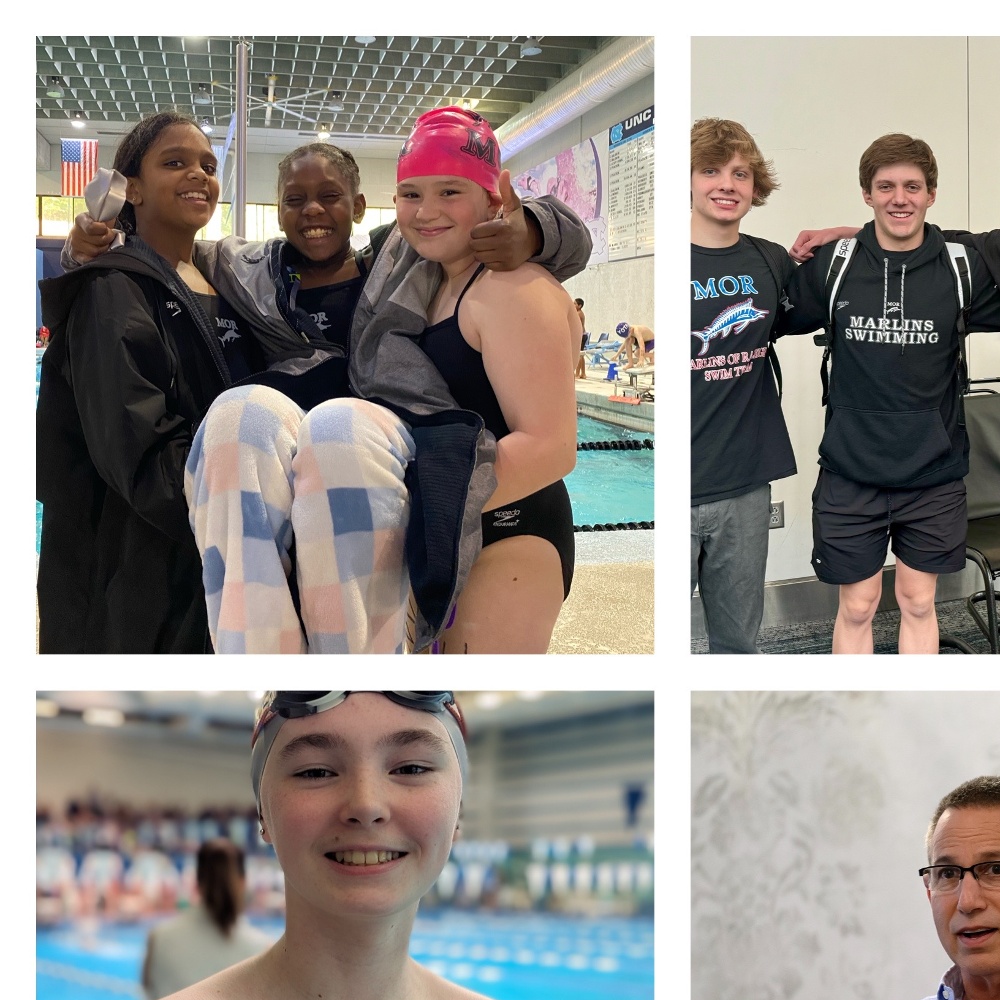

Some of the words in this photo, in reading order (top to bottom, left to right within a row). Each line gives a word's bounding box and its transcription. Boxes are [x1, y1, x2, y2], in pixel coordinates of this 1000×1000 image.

[625, 109, 652, 130] UNC
[690, 275, 759, 301] MOR
[216, 317, 239, 331] MOR
[850, 316, 934, 331] MARLINS
[845, 328, 939, 344] SWIMMING
[727, 353, 740, 365] OF
[704, 367, 734, 382] SWIM
[494, 509, 520, 518] speedo
